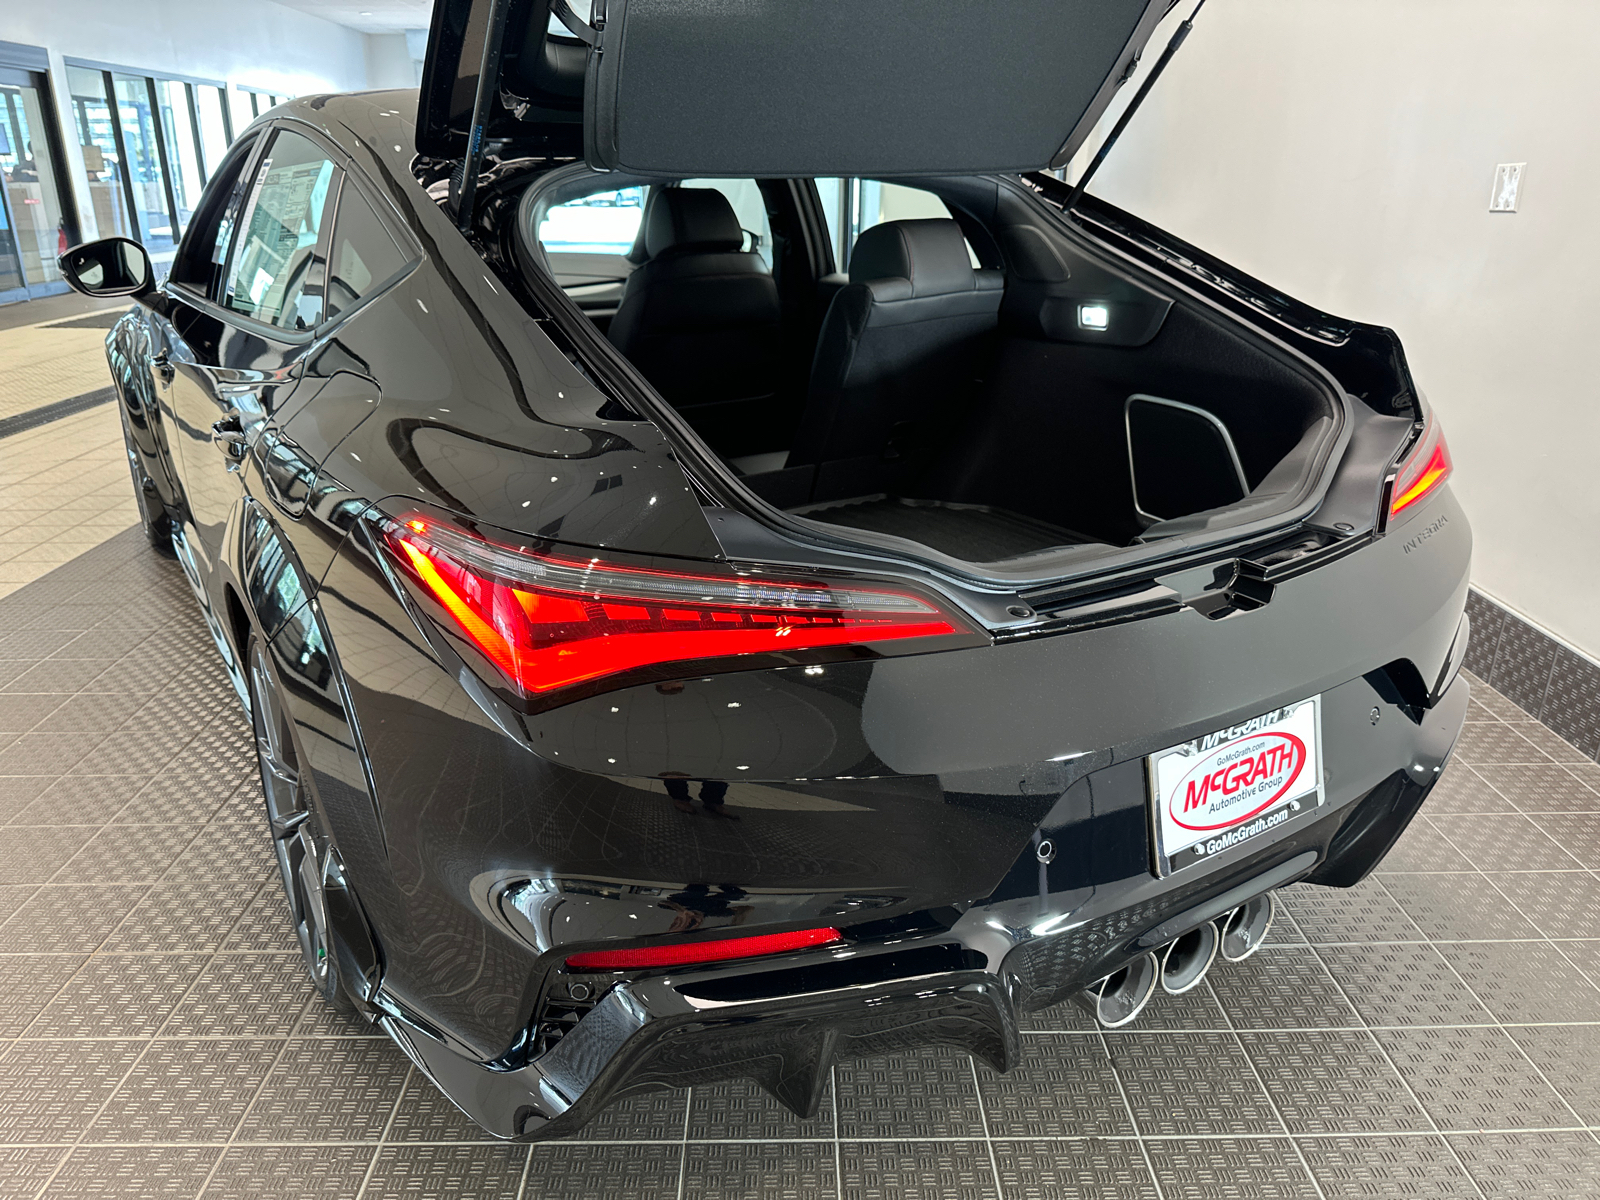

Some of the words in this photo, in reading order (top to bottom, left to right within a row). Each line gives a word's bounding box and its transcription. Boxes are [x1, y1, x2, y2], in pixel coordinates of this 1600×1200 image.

[1403, 515, 1448, 554] INTEGRA
[1216, 741, 1266, 766] GoMcGrath.com
[1209, 788, 1257, 814] Automotive
[1258, 776, 1283, 793] Group
[1206, 809, 1288, 855] GoMcGrath.com
